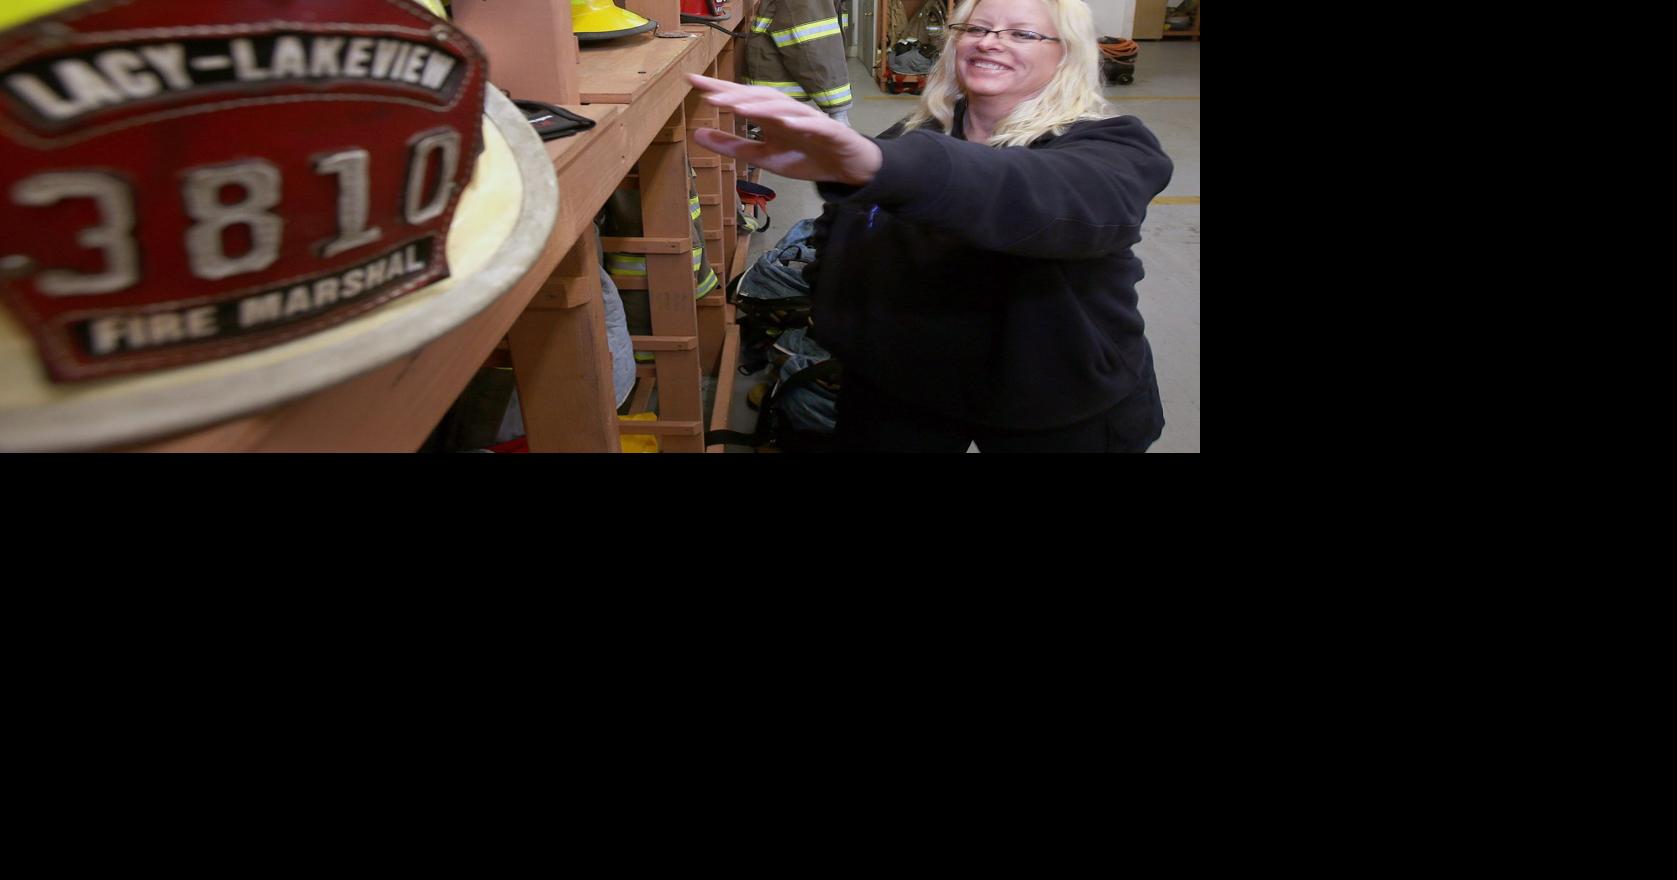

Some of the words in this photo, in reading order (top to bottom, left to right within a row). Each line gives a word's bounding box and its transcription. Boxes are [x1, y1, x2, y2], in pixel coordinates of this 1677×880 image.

[7, 37, 456, 120] LACY-LAKEVIEW
[13, 131, 459, 296] 3810
[91, 307, 218, 354] FIRE
[239, 245, 424, 325] MARSHAL
